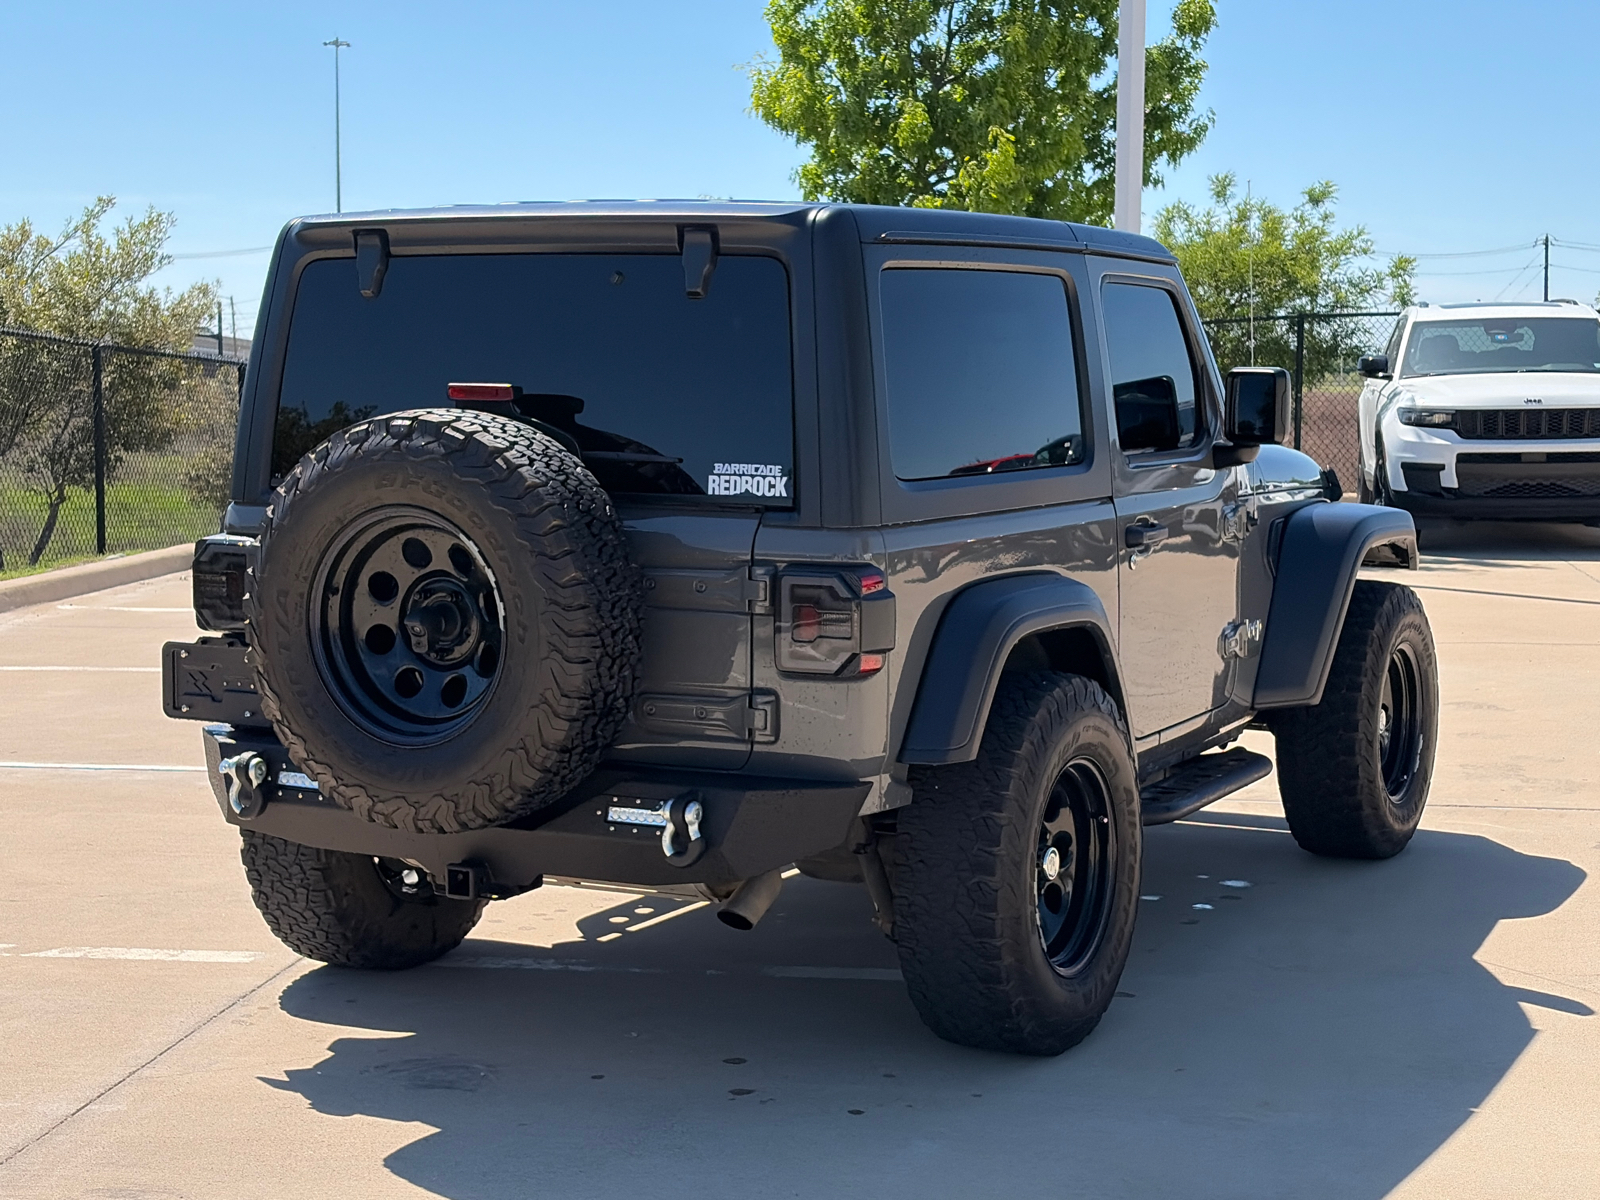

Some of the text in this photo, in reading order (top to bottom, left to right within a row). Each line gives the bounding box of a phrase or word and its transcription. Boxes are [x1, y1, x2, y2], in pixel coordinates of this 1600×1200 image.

[1523, 397, 1543, 405] Jeep
[713, 463, 783, 477] BARRICADE
[707, 475, 789, 497] REDROCK
[373, 472, 530, 646] BFGoodrich
